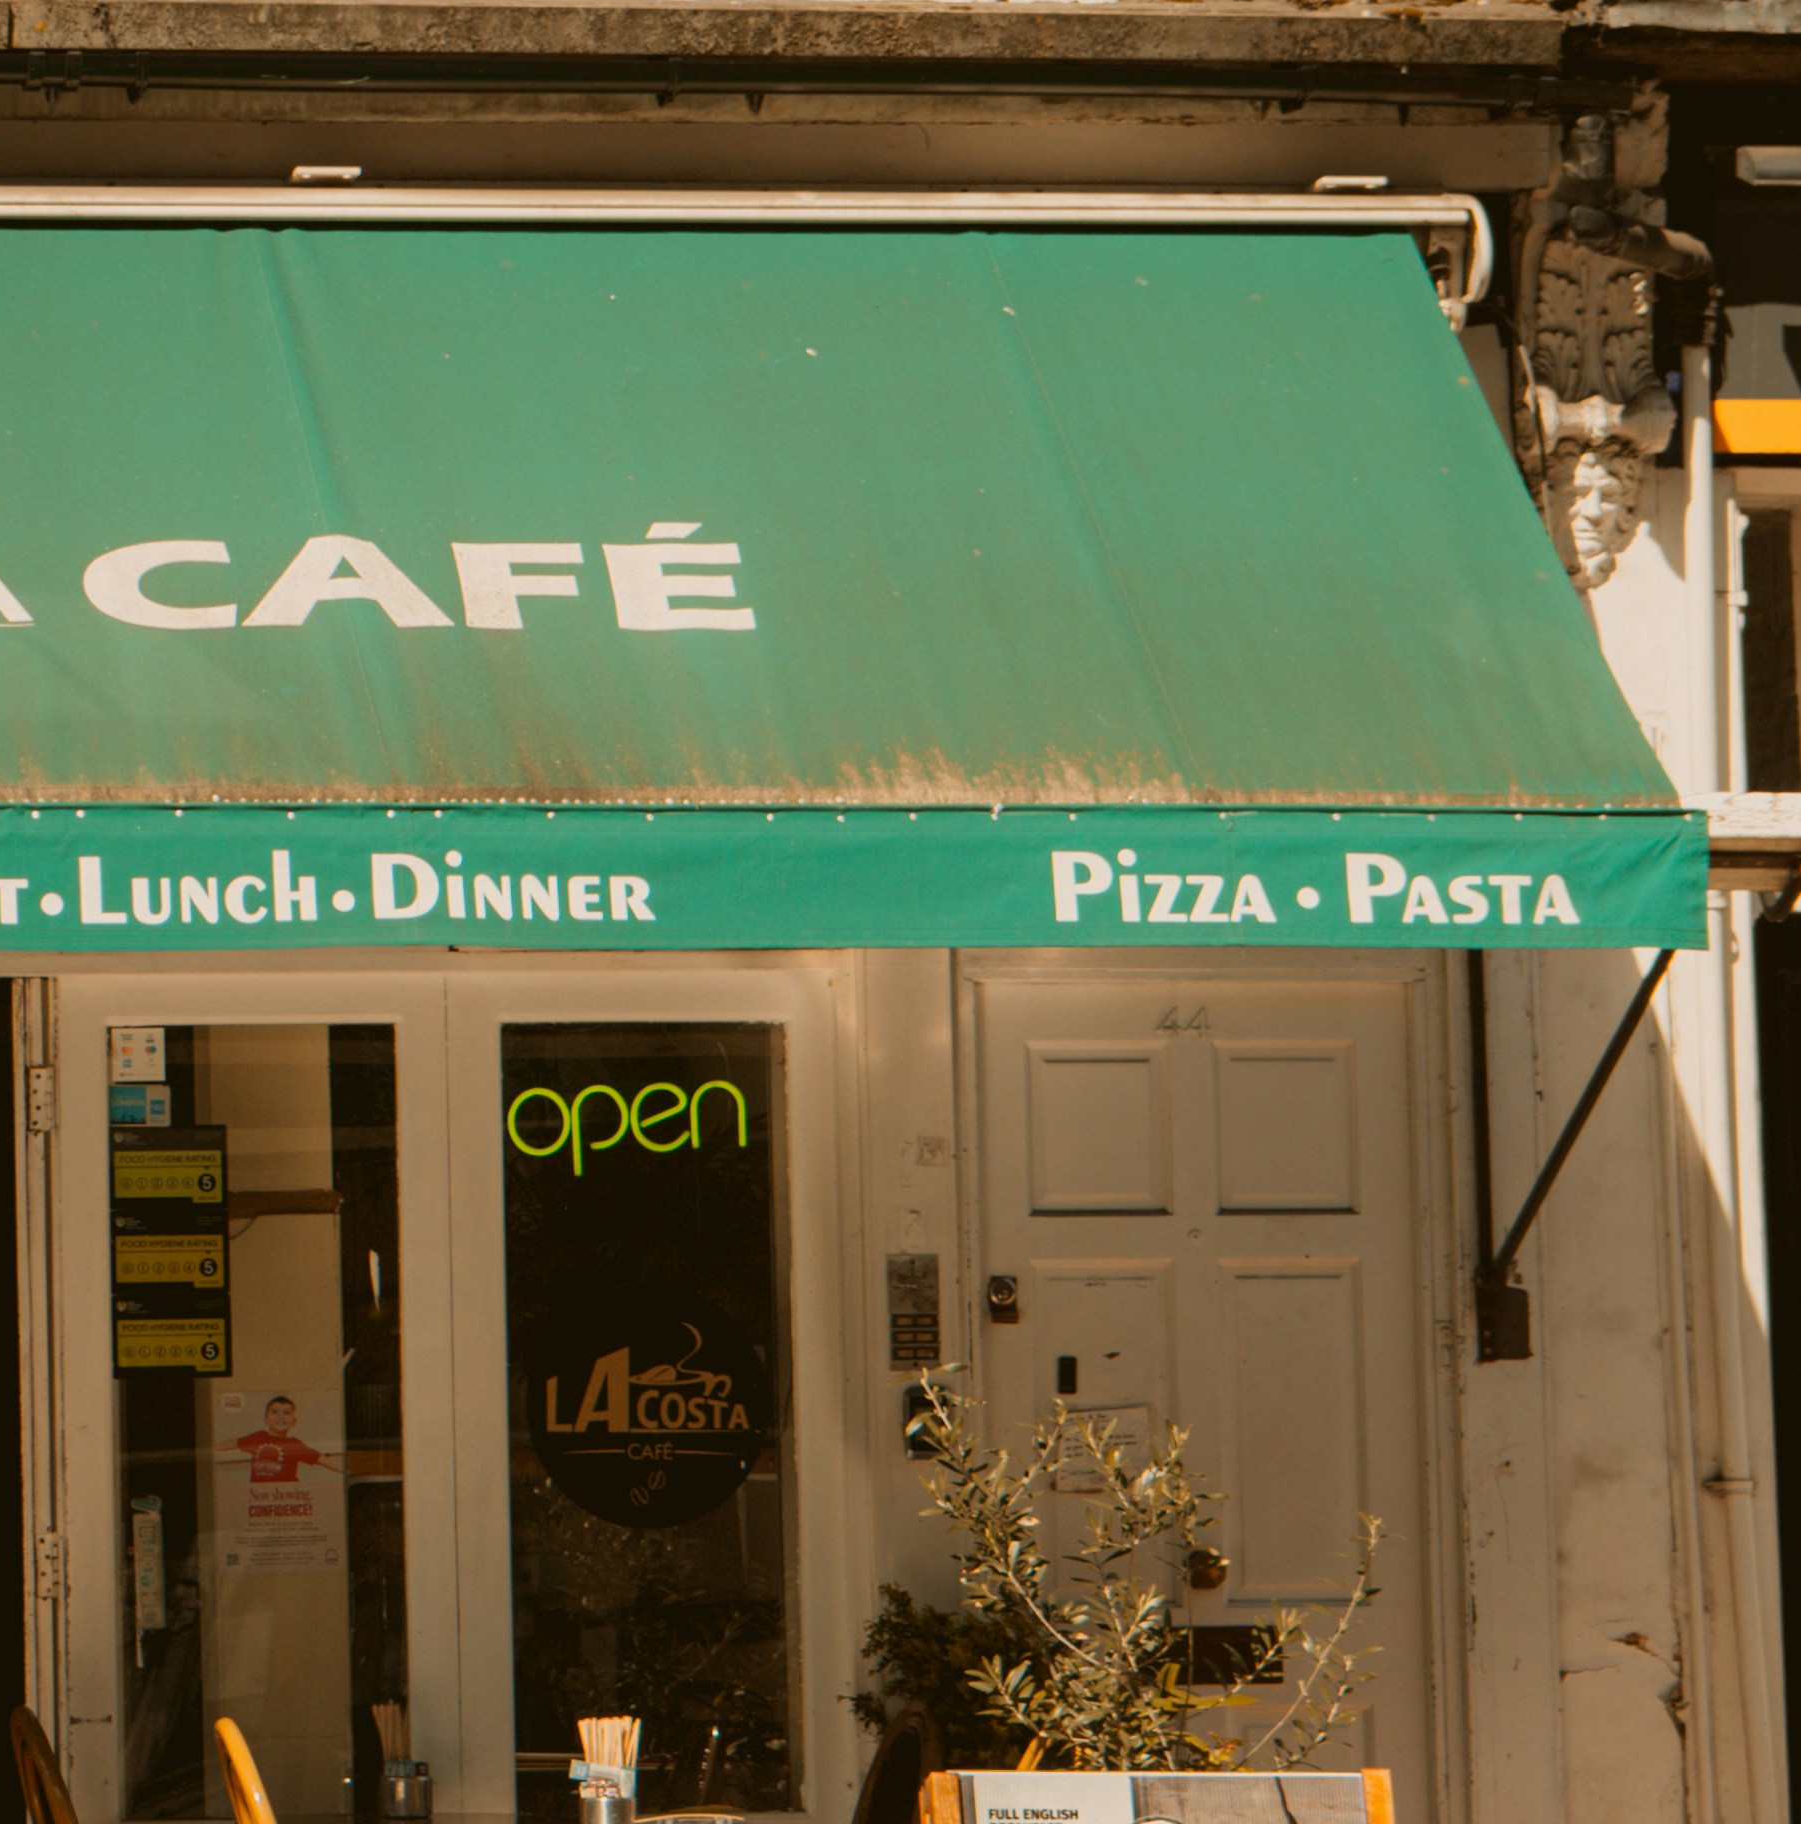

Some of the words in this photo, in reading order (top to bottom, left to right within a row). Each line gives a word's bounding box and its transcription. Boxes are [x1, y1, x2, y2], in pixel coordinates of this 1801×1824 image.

[82, 521, 757, 631] CAFÉ
[1154, 1005, 1211, 1037] 44
[506, 1079, 748, 1176] open
[202, 1176, 213, 1190] 5
[204, 1260, 214, 1275] 5
[205, 1344, 216, 1359] 5
[546, 1346, 630, 1433] LA
[636, 1388, 749, 1430] COSTA
[627, 1441, 674, 1461] CAFÉ
[988, 1808, 1019, 1820] FULL
[1022, 1808, 1079, 1820] ENGLISH
